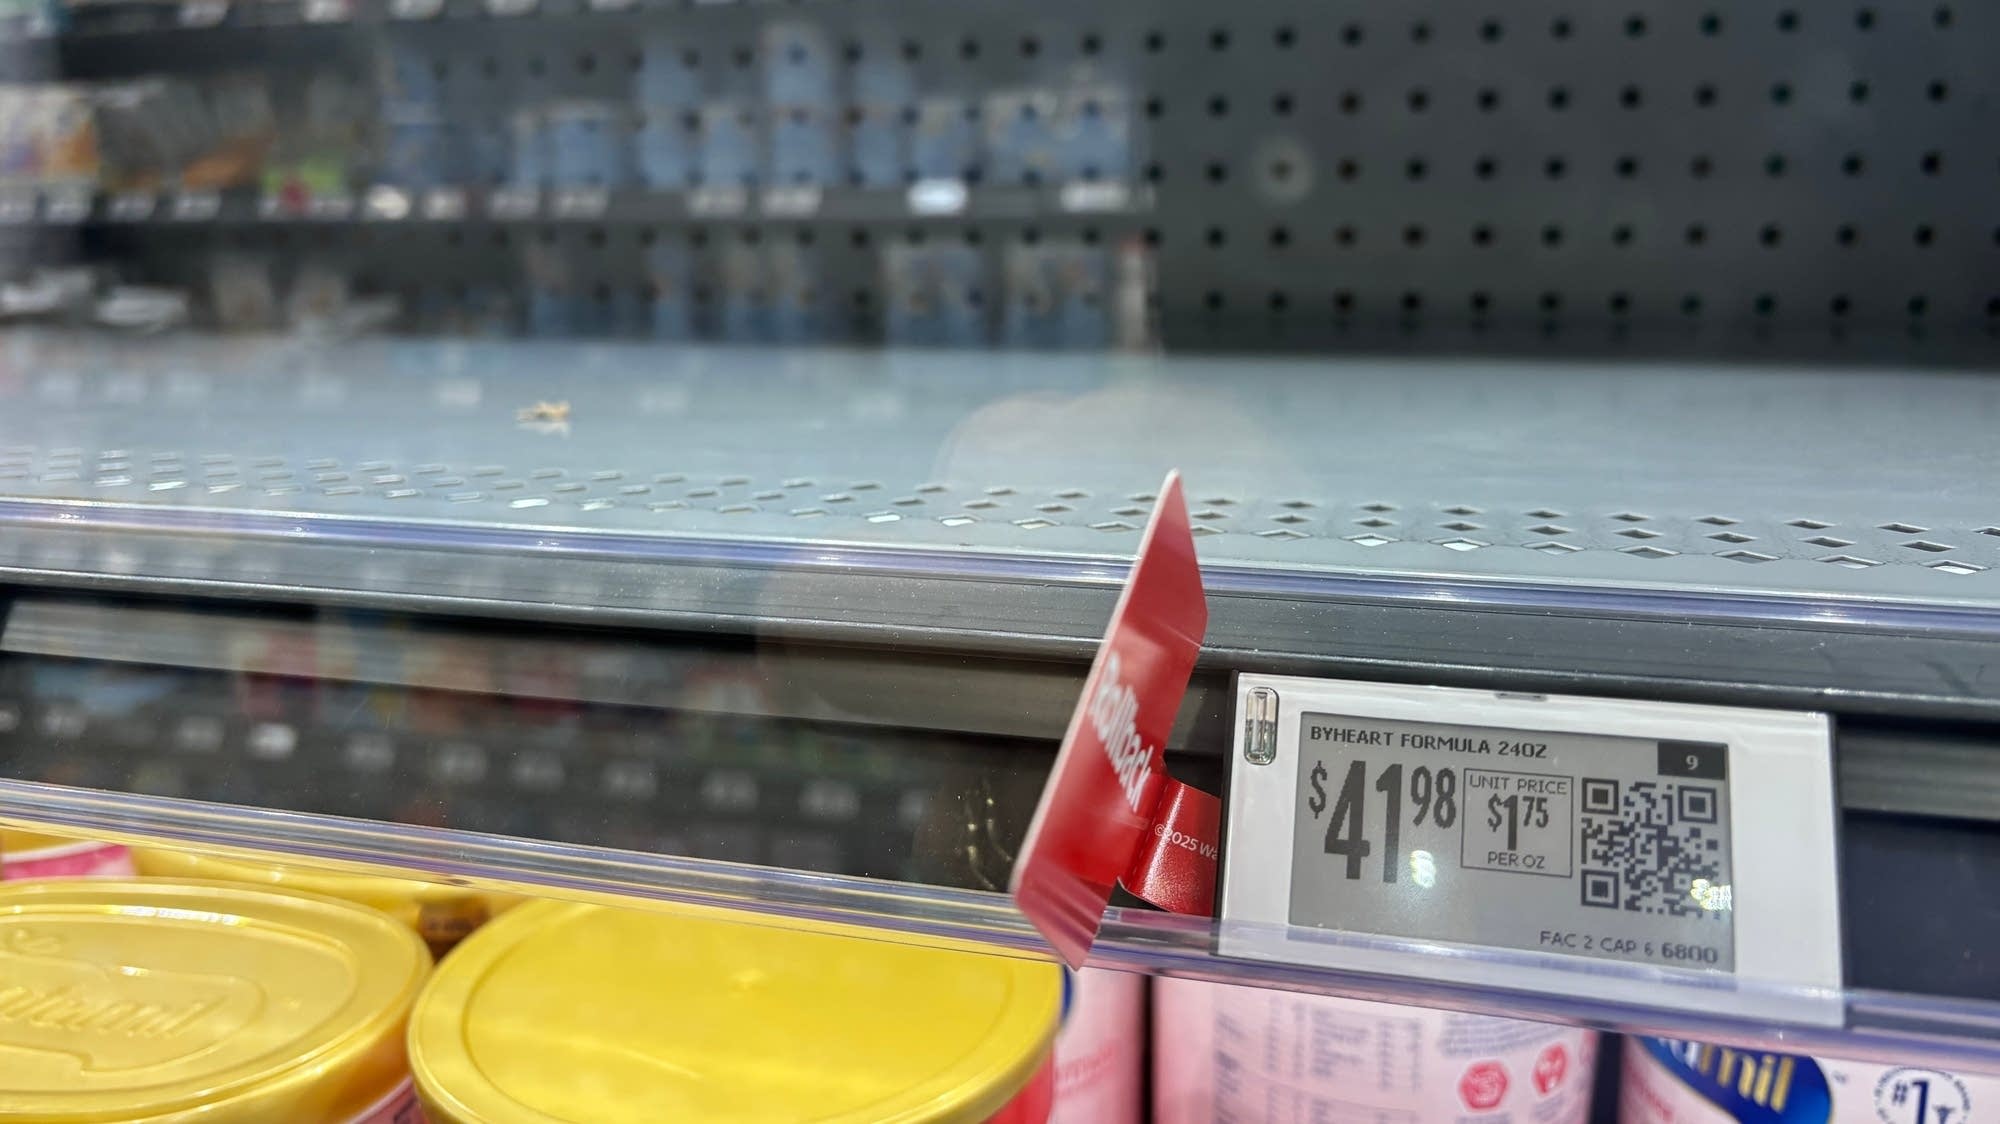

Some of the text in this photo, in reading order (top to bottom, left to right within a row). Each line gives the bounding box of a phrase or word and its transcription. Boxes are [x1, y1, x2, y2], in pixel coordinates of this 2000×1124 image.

[1310, 726, 1394, 747] BYHEART
[1400, 733, 1491, 754] FORMULA
[1684, 754, 1699, 770] 9
[1469, 774, 1568, 796] UNIT PRICE
[1199, 842, 1219, 861] Wa
[1487, 851, 1546, 869] PER OZ
[1539, 930, 1577, 948] FAC
[1583, 935, 1593, 950] 2
[1600, 937, 1637, 954] CAP
[1661, 942, 1719, 964] 6800
